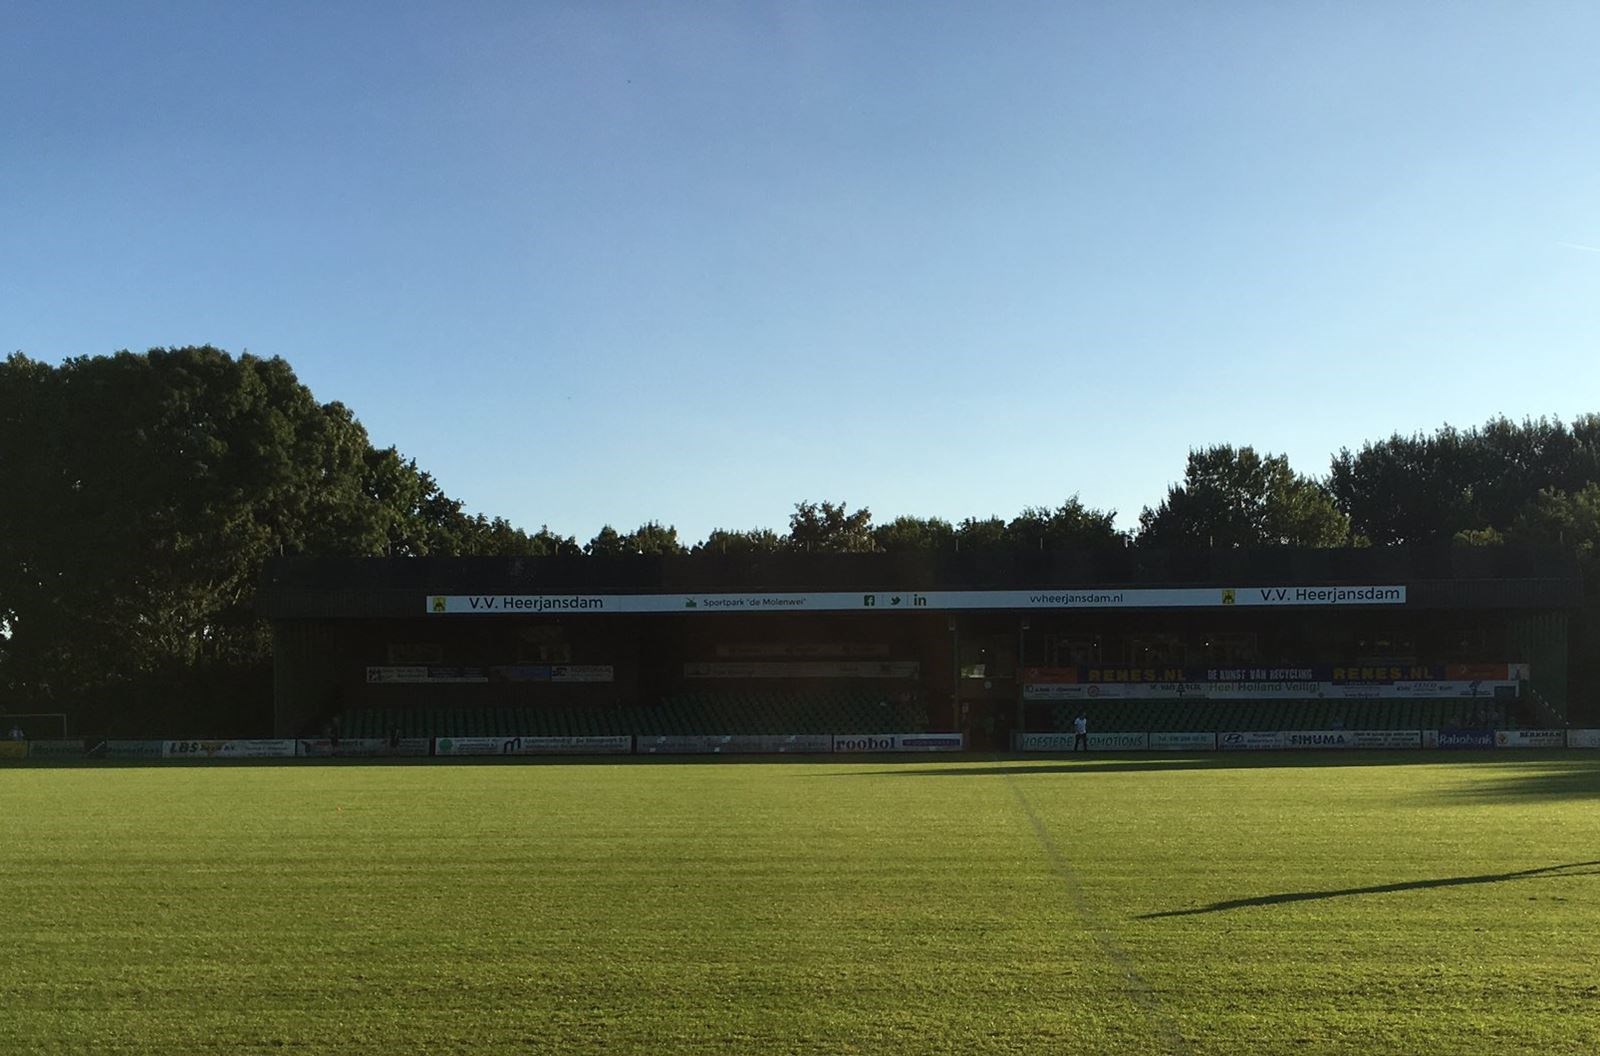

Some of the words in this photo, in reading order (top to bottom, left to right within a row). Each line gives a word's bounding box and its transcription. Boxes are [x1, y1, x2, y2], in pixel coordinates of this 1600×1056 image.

[1030, 593, 1123, 605] vvheerjansdam.nl
[1261, 589, 1290, 601] V.V.
[1296, 587, 1400, 603] Heerjansdam
[469, 597, 498, 609] V.V.
[503, 596, 603, 611] Heerjansdam
[703, 598, 744, 608] Sportpark
[1088, 668, 1187, 681] RENES.NL
[1250, 669, 1266, 680] VAN
[1333, 667, 1434, 680] RENES.NL
[1238, 682, 1282, 692] Holland
[836, 737, 895, 750] roobol
[1078, 735, 1143, 747] OMOTIONS
[1440, 734, 1492, 746] Rabobank
